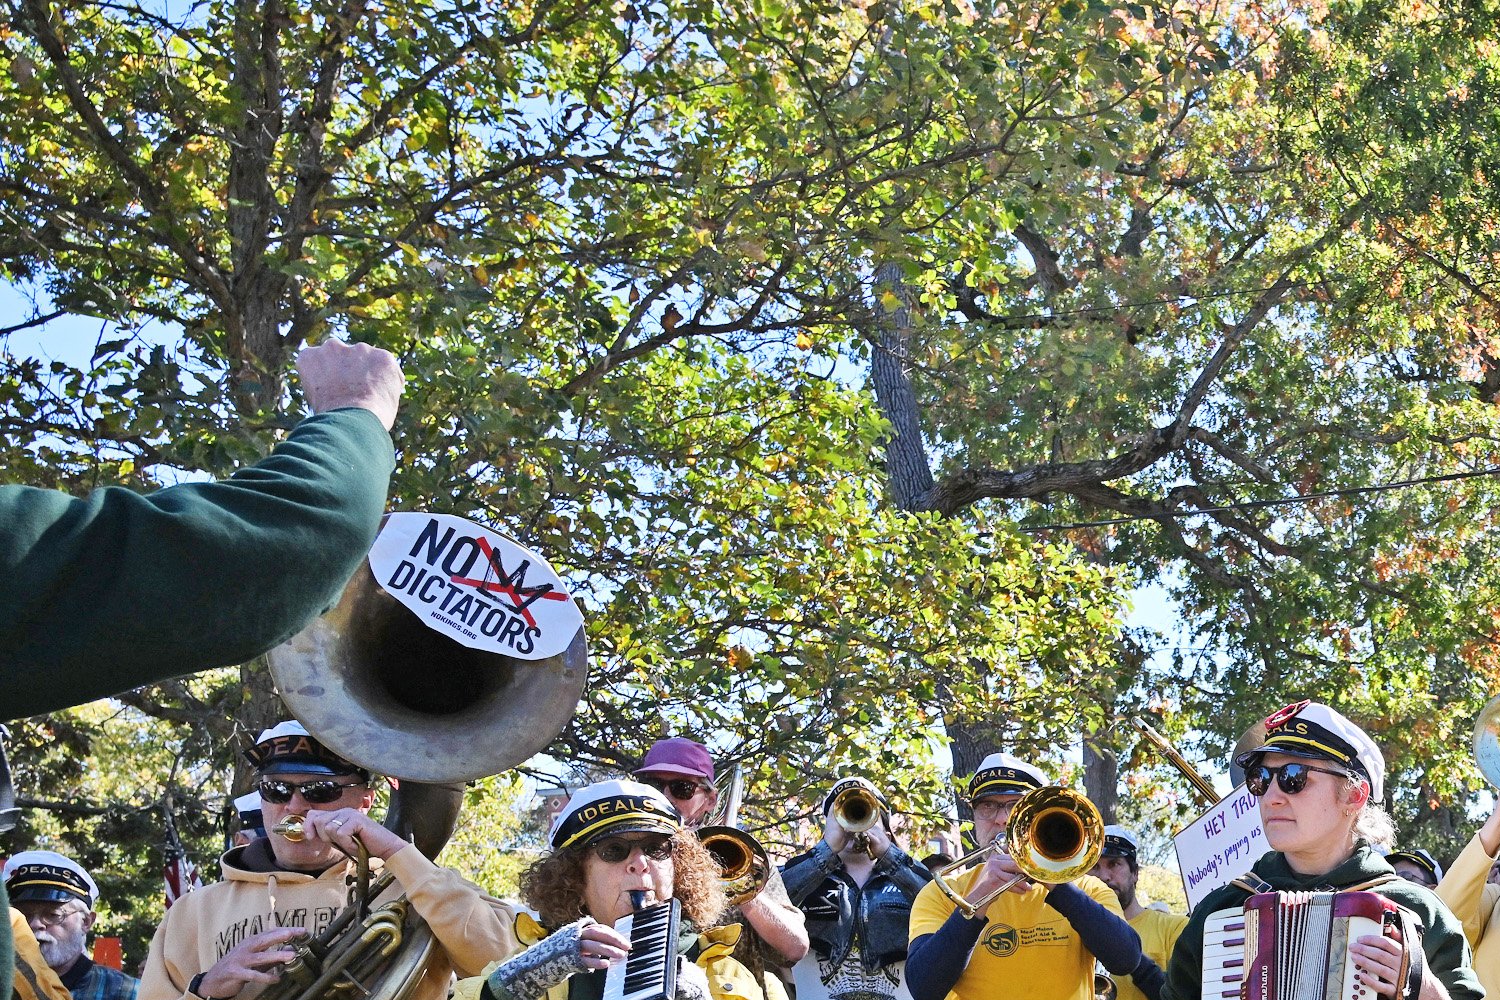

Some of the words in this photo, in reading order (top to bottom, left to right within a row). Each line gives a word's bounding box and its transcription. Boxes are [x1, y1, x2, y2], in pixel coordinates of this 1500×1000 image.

[409, 518, 481, 579] NO
[388, 560, 541, 654] DICTATORS
[430, 611, 478, 641] NOKINGS.ORG
[250, 736, 313, 760] IDEA
[577, 798, 656, 824] IDEALS
[1203, 811, 1226, 839] HEY
[1231, 793, 1259, 819] TRU
[19, 866, 72, 879] DEALS
[1188, 854, 1222, 889] Nobody's
[1224, 836, 1250, 865] paying
[1251, 825, 1262, 838] us
